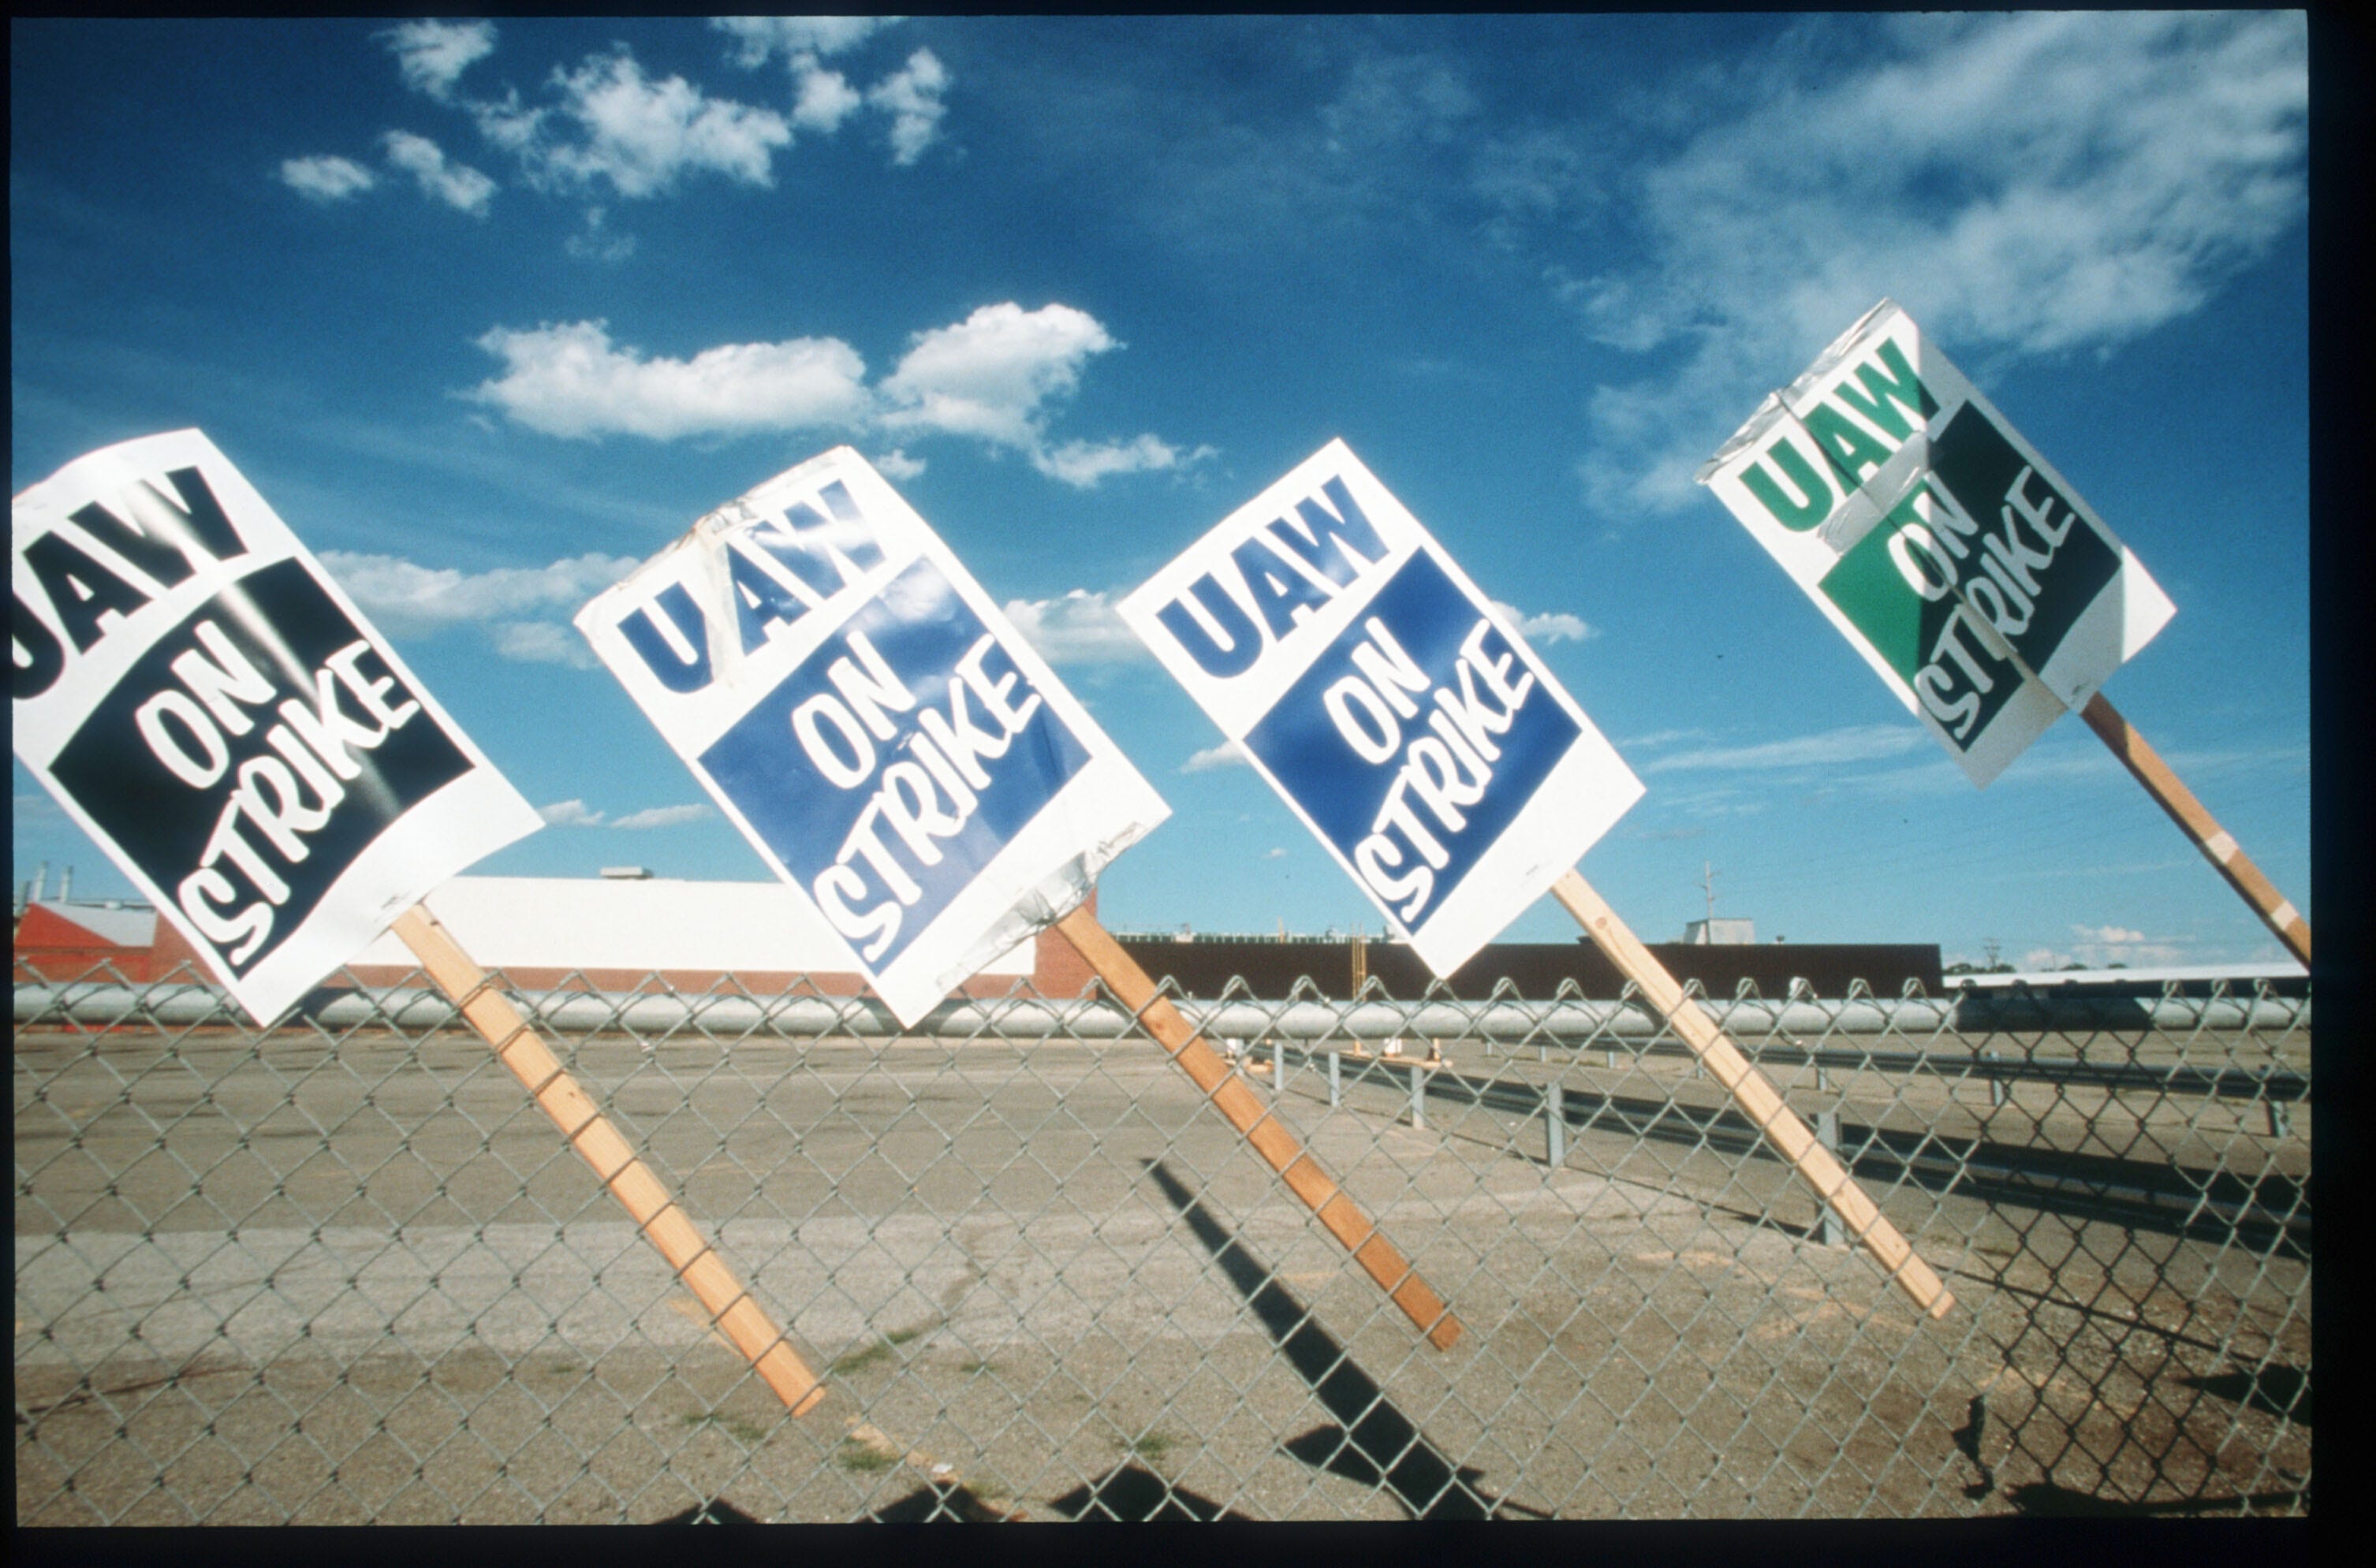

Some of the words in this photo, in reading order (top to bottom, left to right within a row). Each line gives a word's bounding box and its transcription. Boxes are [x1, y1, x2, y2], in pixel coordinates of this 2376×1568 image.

[1739, 338, 1939, 532] UAW
[1888, 471, 1978, 601] ON
[617, 479, 886, 694] UAW
[1156, 475, 1389, 678] UAW
[1915, 466, 2075, 739] STRIKE
[136, 621, 276, 788] ON
[793, 631, 916, 789] ON
[1323, 617, 1430, 763] ON
[1354, 619, 1534, 922] STRIKE
[179, 640, 420, 964] STRIKE
[813, 633, 1041, 963] STRIKE
